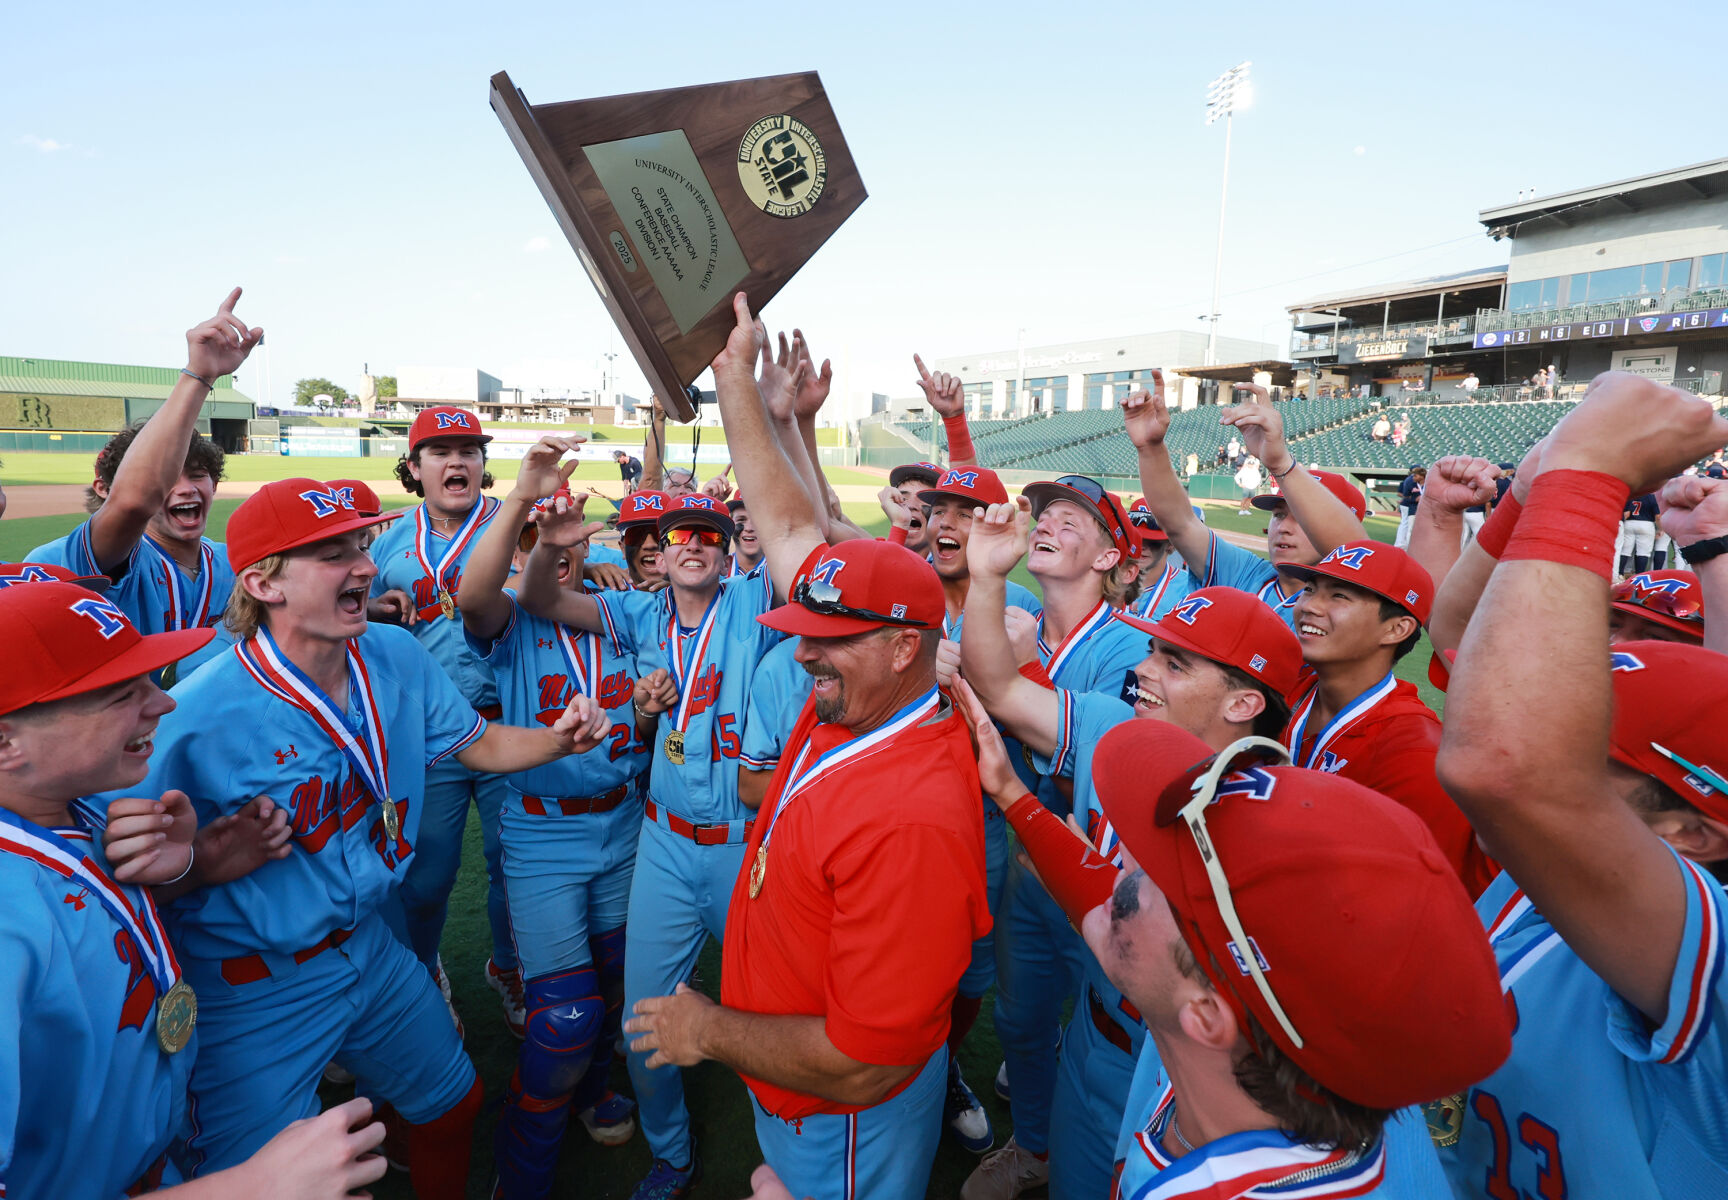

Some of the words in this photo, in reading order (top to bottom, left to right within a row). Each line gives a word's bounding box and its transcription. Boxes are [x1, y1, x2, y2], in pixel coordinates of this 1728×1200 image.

[740, 117, 782, 162] UNIVERSITY
[635, 158, 686, 184] UNIVERSITY
[754, 156, 779, 196] STATE
[762, 129, 810, 201] UIL
[791, 120, 826, 204] INTERSCHOLASTIC
[631, 186, 666, 246] CONFERENCE
[656, 187, 676, 214] STATE
[671, 214, 698, 260] CHAMPION
[684, 181, 718, 258] INTERSCHOLASTIC
[766, 202, 805, 217] LEAGUE
[635, 218, 658, 257] DIVISION
[655, 207, 680, 252] BASEBALL
[614, 240, 633, 264] 2025
[699, 257, 717, 292] LEAGUE
[1504, 333, 1511, 342] R
[1518, 331, 1525, 342] 2
[1540, 330, 1548, 339] H
[1557, 327, 1564, 338] 6
[1583, 326, 1590, 335] E
[1672, 317, 1680, 327] R
[1691, 314, 1699, 326] 6
[434, 411, 471, 429] M
[942, 470, 979, 488] M
[301, 486, 355, 518] M
[633, 494, 663, 512] M
[682, 496, 715, 511] M
[1632, 501, 1641, 515] 7
[1319, 544, 1375, 571] M
